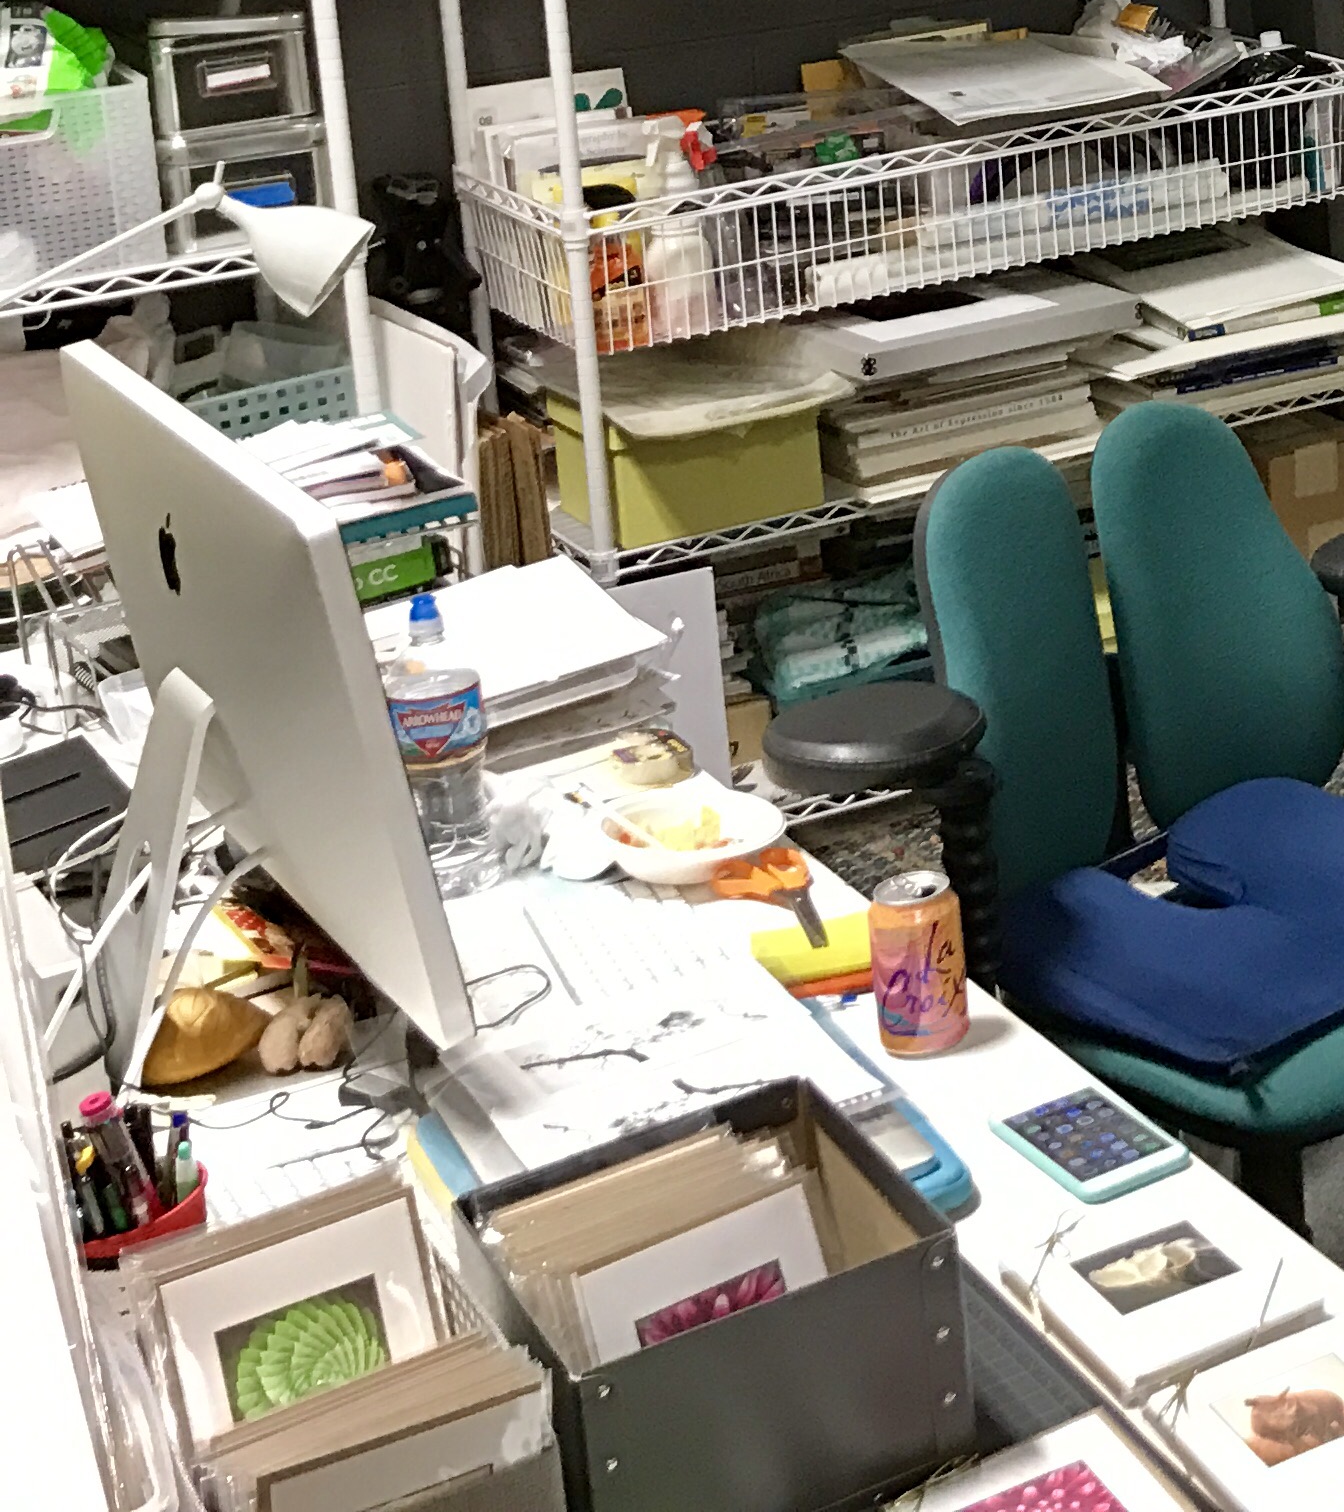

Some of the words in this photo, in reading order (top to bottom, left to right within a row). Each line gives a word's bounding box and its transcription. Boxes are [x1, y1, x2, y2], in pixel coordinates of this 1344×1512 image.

[913, 424, 929, 435] Art
[933, 420, 944, 430] of
[369, 563, 399, 586] CC
[402, 709, 463, 728] ARROWHEAD
[921, 919, 956, 984] La
